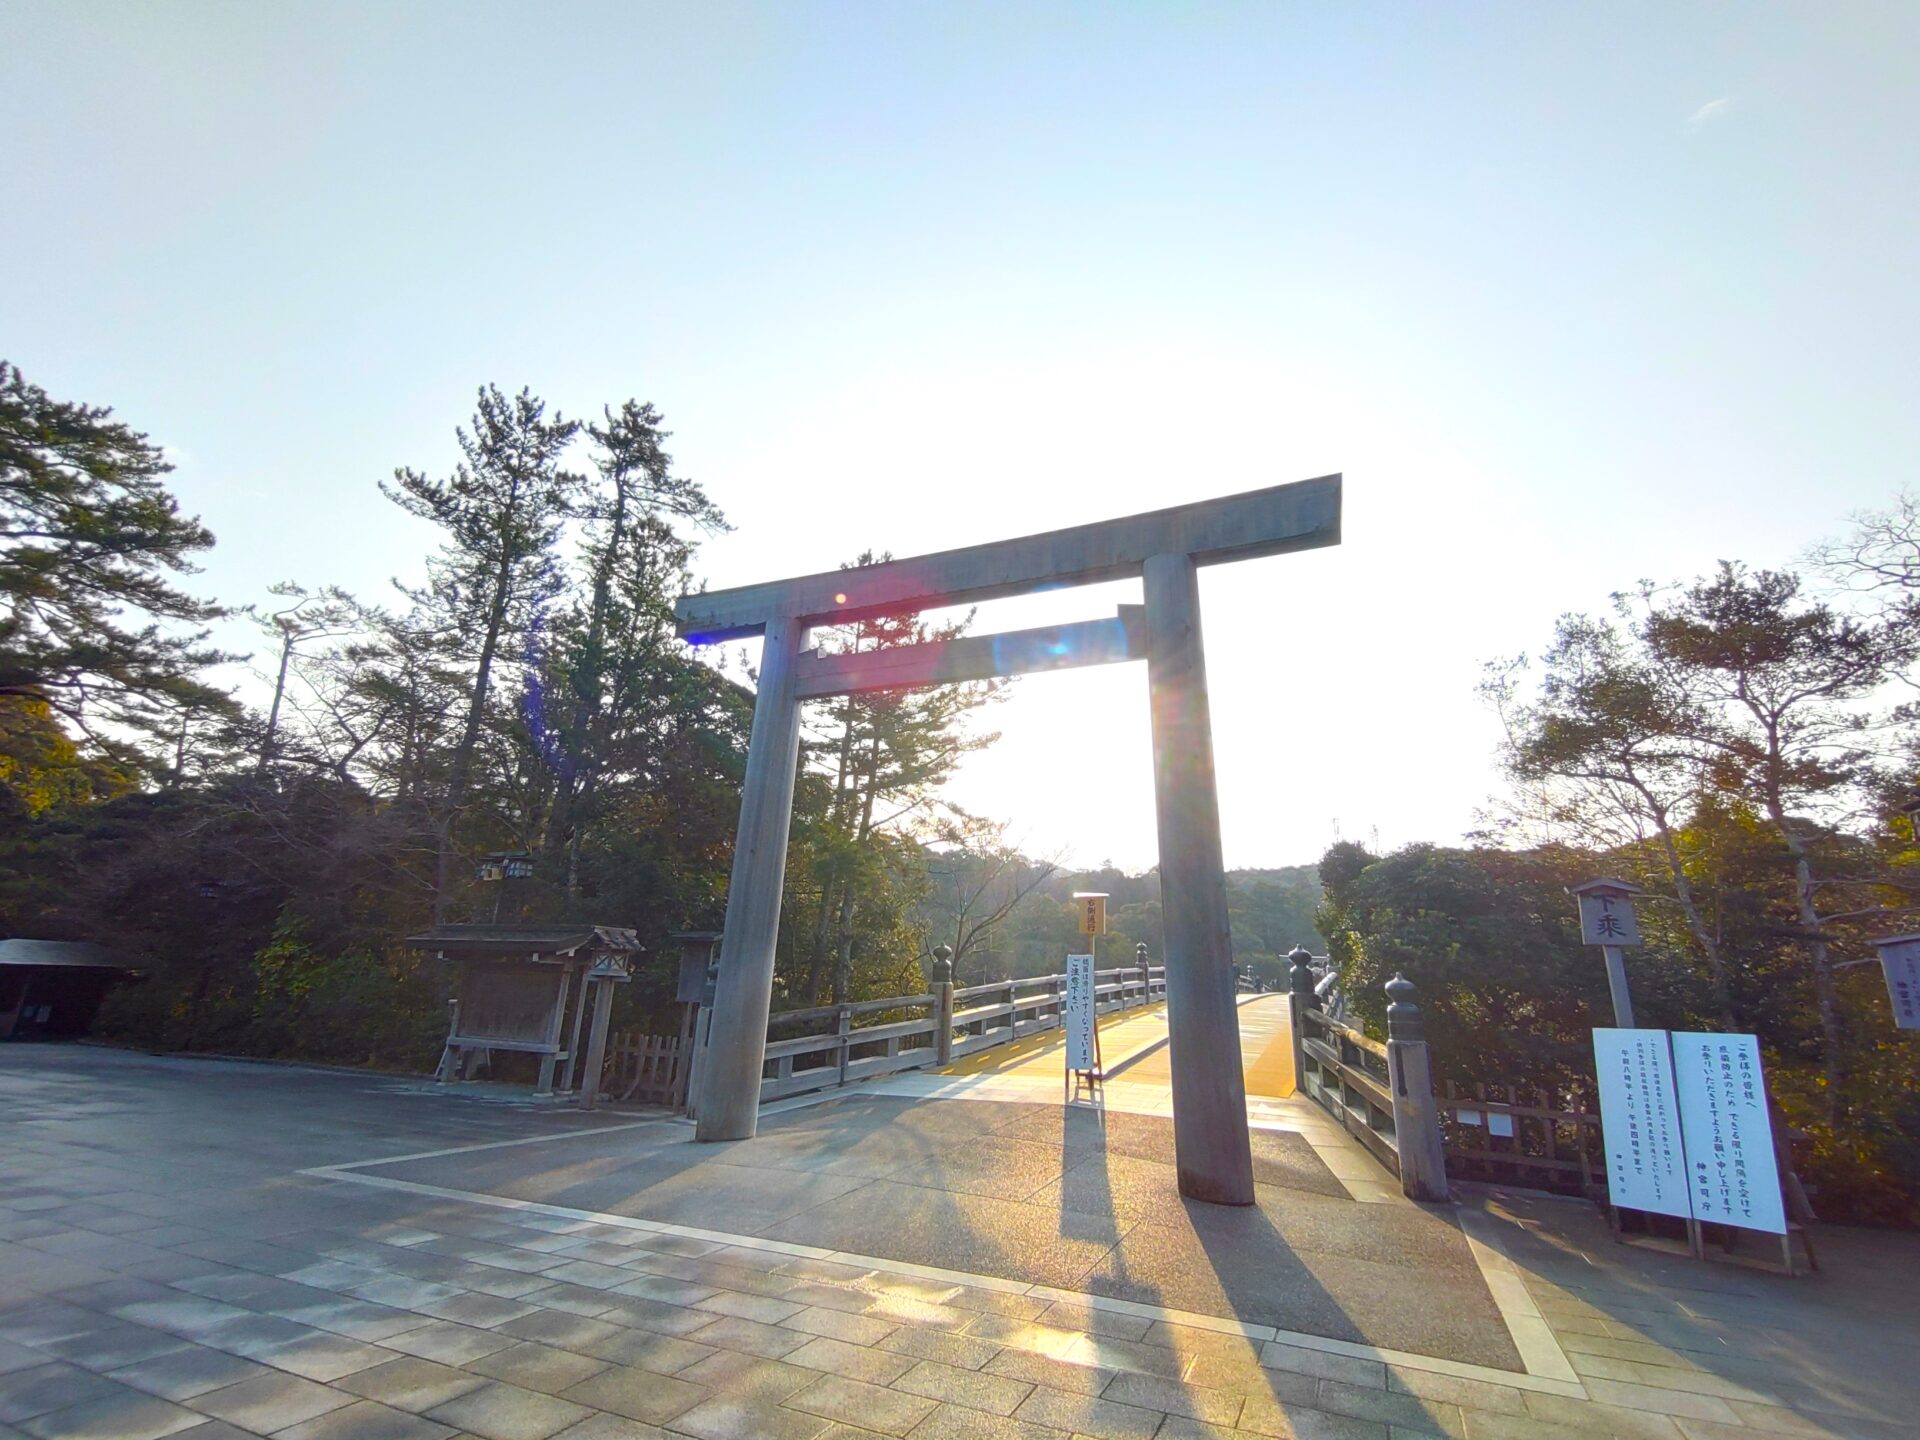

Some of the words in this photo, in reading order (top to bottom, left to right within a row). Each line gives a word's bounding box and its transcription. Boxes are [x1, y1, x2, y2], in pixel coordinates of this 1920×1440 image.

[1592, 894, 1627, 938] 下乗
[1070, 958, 1081, 1012] ご注意下さい
[1738, 1043, 1757, 1109] ご参拝の皆様へ
